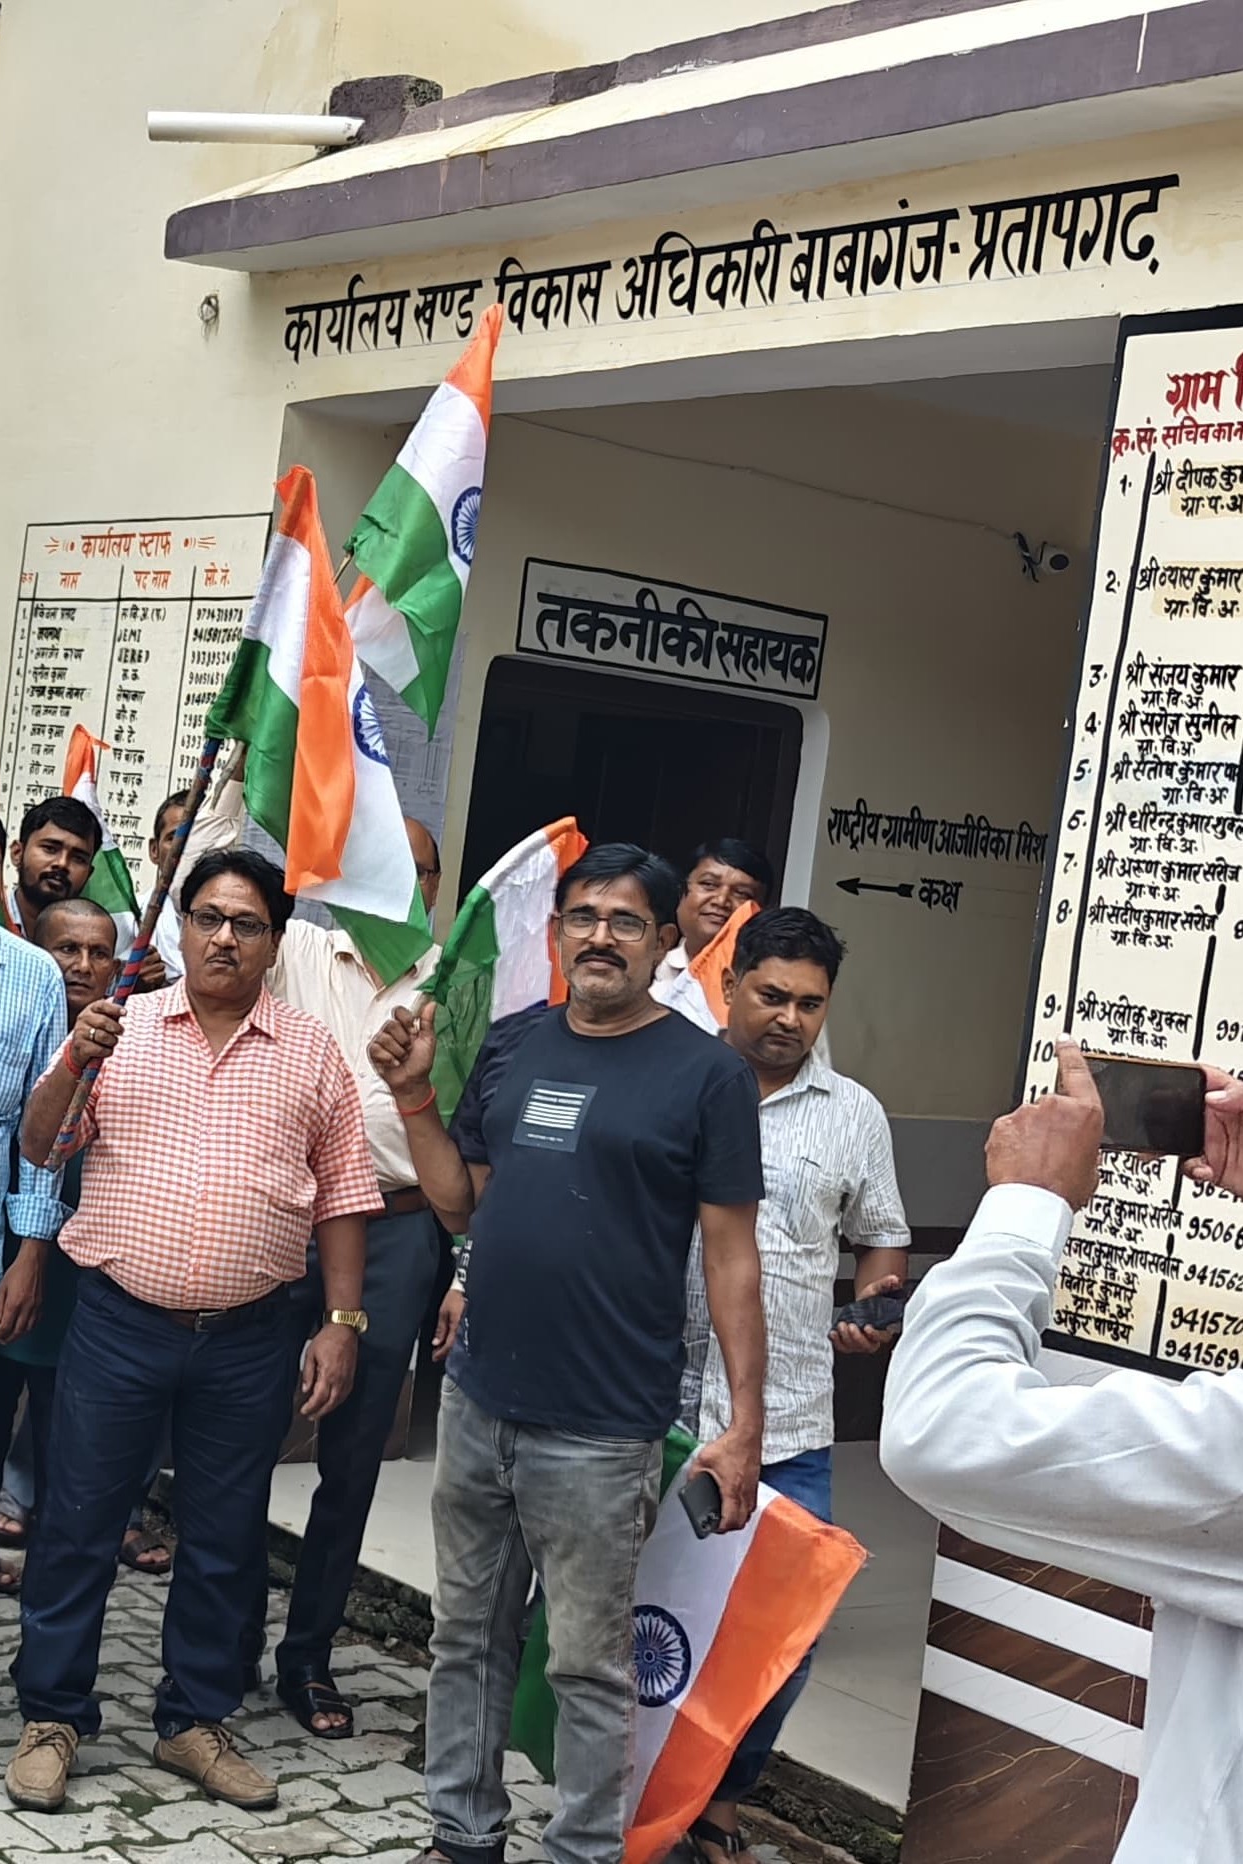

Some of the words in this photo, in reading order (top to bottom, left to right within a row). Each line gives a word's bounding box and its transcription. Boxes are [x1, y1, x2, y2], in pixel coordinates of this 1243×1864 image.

[285, 274, 411, 365] कार्यालय
[414, 280, 483, 343] खण्ड
[495, 257, 612, 335] विकास
[615, 219, 792, 321] अधिकारी
[968, 174, 1180, 275] प्रतापगढ़
[1166, 370, 1230, 417] ग्राम
[1162, 416, 1215, 449] सचिव
[1152, 458, 1174, 495] श्री
[1176, 458, 1218, 493] दीपक
[81, 527, 136, 559] कार्यालय
[138, 532, 172, 558] स्टाफ
[1136, 556, 1159, 590] श्री
[1159, 566, 1199, 590] व्यास
[1198, 567, 1243, 595] कुमार
[536, 588, 719, 670] तकनीकी
[716, 621, 819, 687] सहायक
[1126, 650, 1149, 689] श्री
[1148, 656, 1191, 690] संजय
[1191, 663, 1243, 694] कुमार
[1118, 699, 1140, 738] श्री
[1140, 706, 1184, 737] सरोज
[1185, 701, 1241, 742] सुनील
[1111, 752, 1132, 784] श्री
[1132, 753, 1178, 782] संतोष
[1177, 759, 1224, 785] कुमार
[827, 797, 882, 852] राष्ट्रीय
[881, 806, 938, 855] ग्रामीण
[935, 813, 1014, 862] आजीविका
[1105, 803, 1127, 836] श्री
[1177, 809, 1213, 836] कुमार
[1095, 849, 1115, 882] श्री
[1160, 860, 1202, 884] कुमार
[1202, 856, 1242, 884] सरोज
[918, 877, 963, 913] कक्ष
[1088, 896, 1107, 925] श्री
[1107, 899, 1142, 925] संदीप
[1142, 907, 1181, 932] कुमार
[1180, 904, 1219, 932] सरोज
[1076, 991, 1098, 1022] श्री
[1147, 1007, 1192, 1034] शुक्ल
[1114, 1199, 1150, 1229] कुमार
[1149, 1199, 1184, 1231] सरोज
[1094, 1240, 1128, 1270] कुमार
[1059, 1265, 1098, 1300] विनोद
[1053, 1304, 1092, 1336] अंकुर
